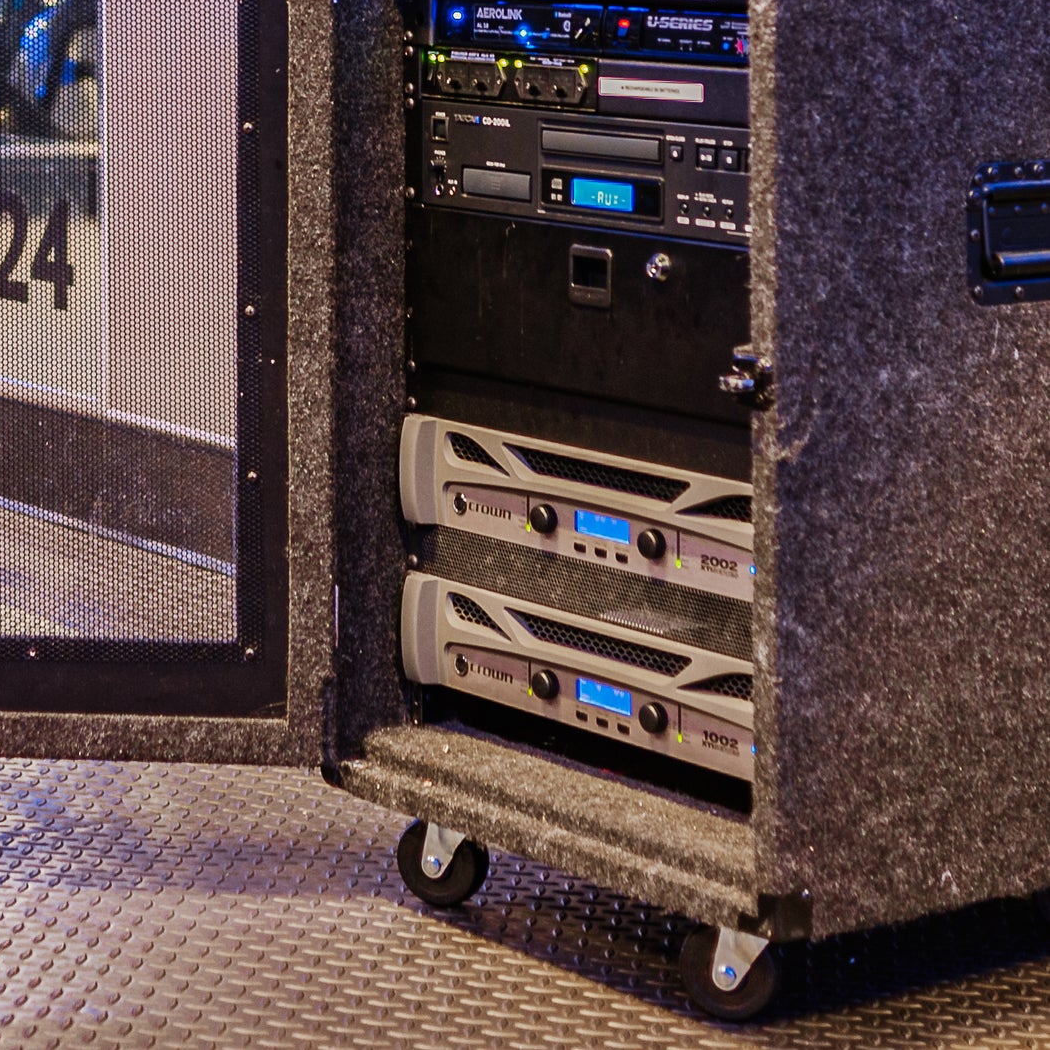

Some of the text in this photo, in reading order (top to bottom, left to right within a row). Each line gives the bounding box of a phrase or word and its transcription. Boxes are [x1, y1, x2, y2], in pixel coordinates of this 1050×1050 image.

[476, 7, 523, 20] AEROLINK
[647, 15, 713, 31] U-SERIES
[468, 501, 512, 521] crown
[701, 554, 738, 572] 2002
[470, 663, 513, 685] crown
[703, 730, 739, 750] 1002
